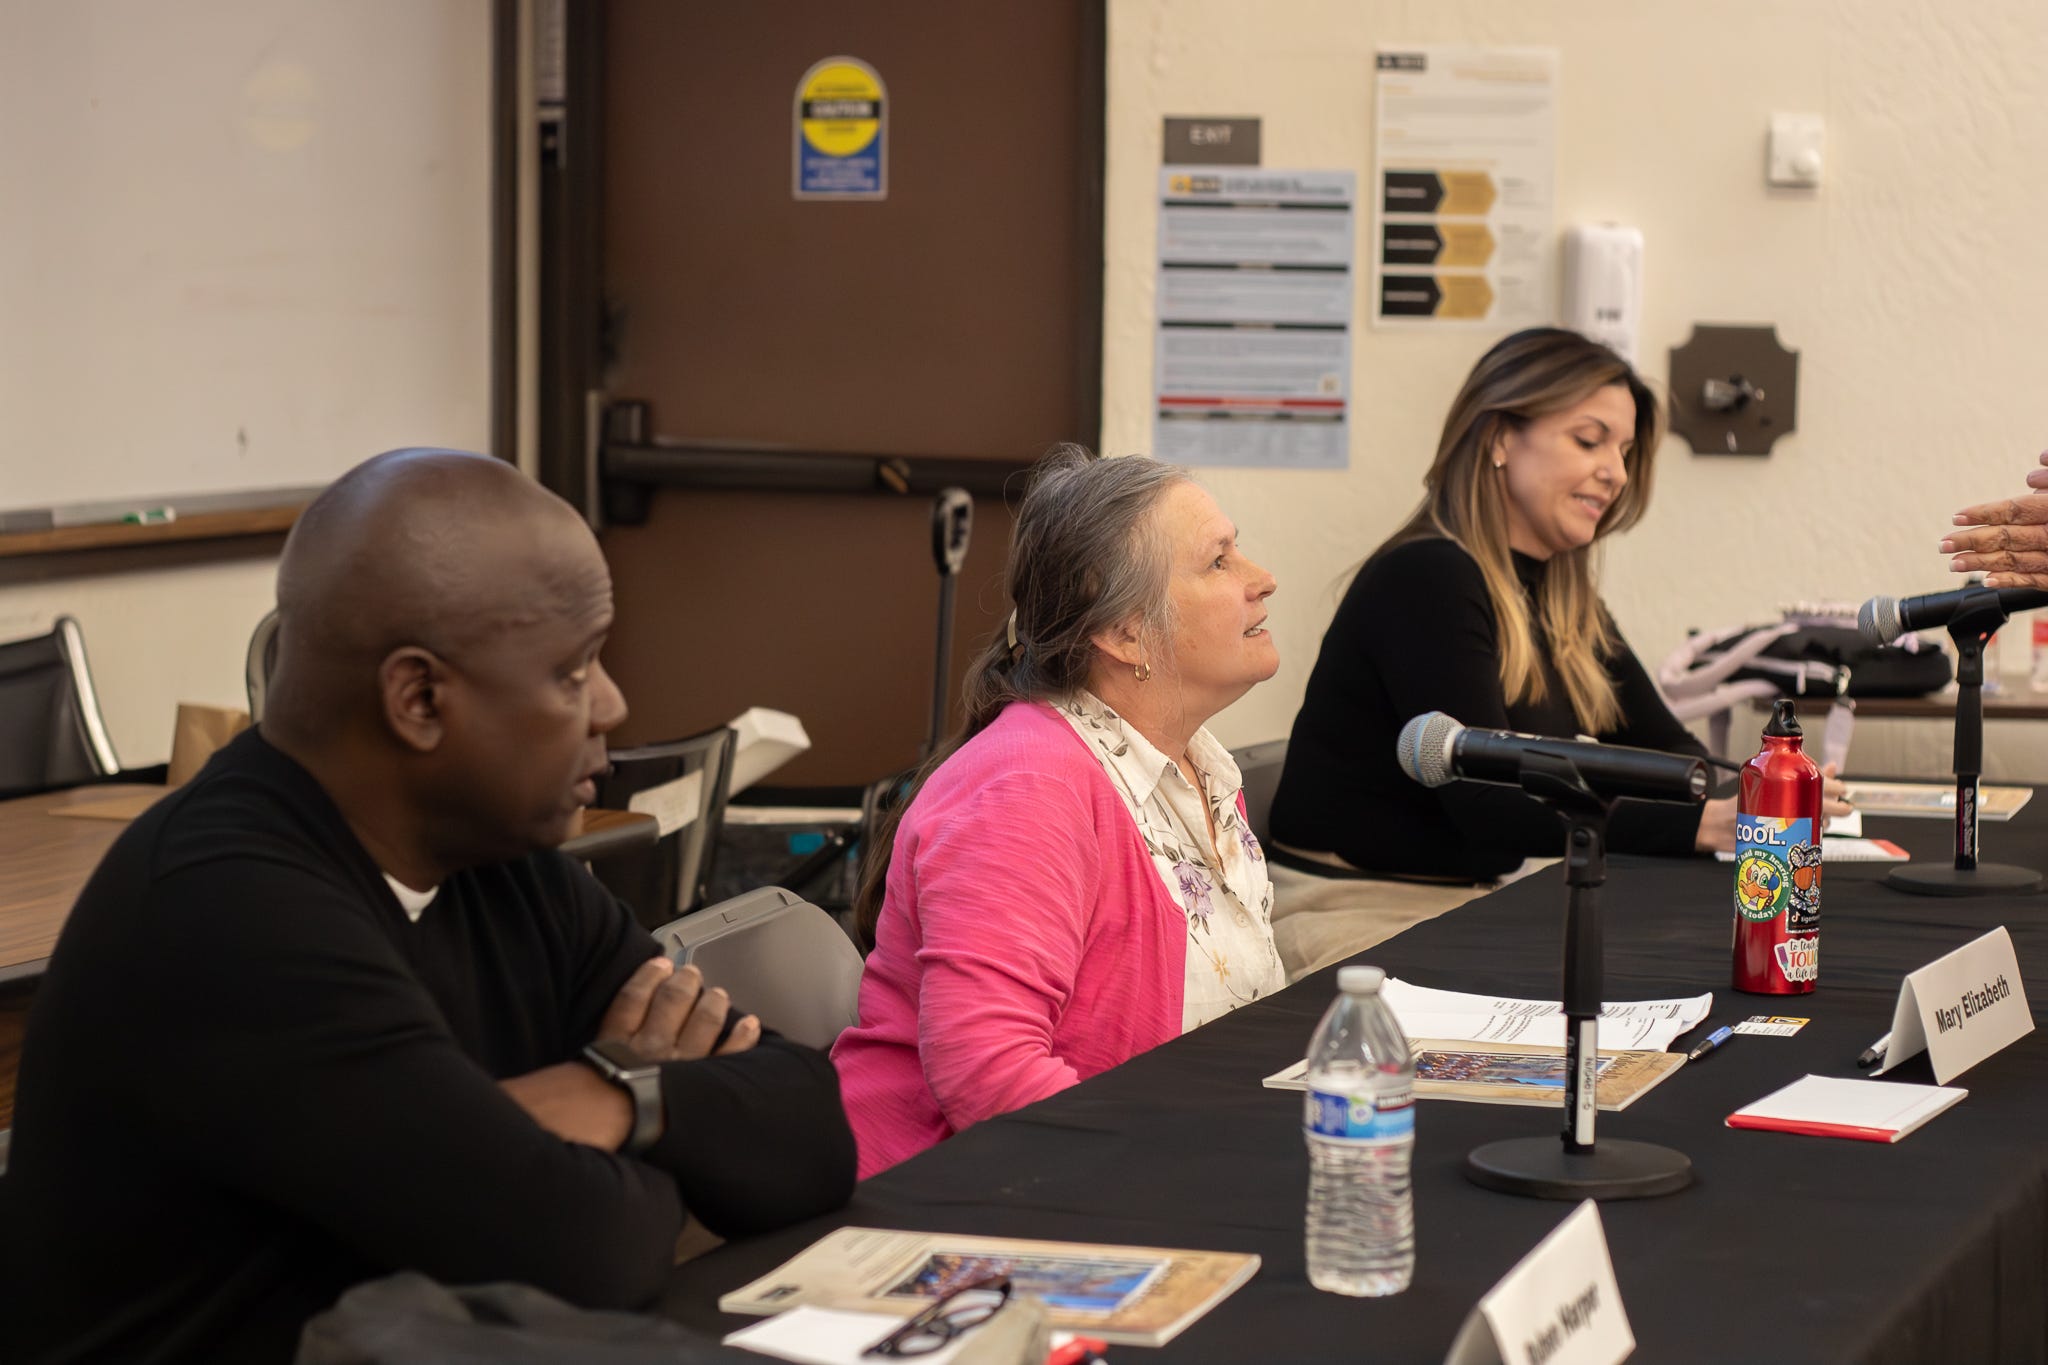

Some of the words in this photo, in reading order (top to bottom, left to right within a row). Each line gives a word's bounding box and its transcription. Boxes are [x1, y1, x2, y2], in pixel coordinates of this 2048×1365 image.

[1189, 124, 1232, 145] EXIT
[1736, 823, 1787, 846] COOL.
[1754, 850, 1768, 858] my
[1769, 854, 1790, 888] hearing
[1748, 906, 1778, 919] today!
[1790, 940, 1798, 951] to
[1934, 1005, 1964, 1035] Mary
[1961, 974, 2011, 1019] Elizabeth
